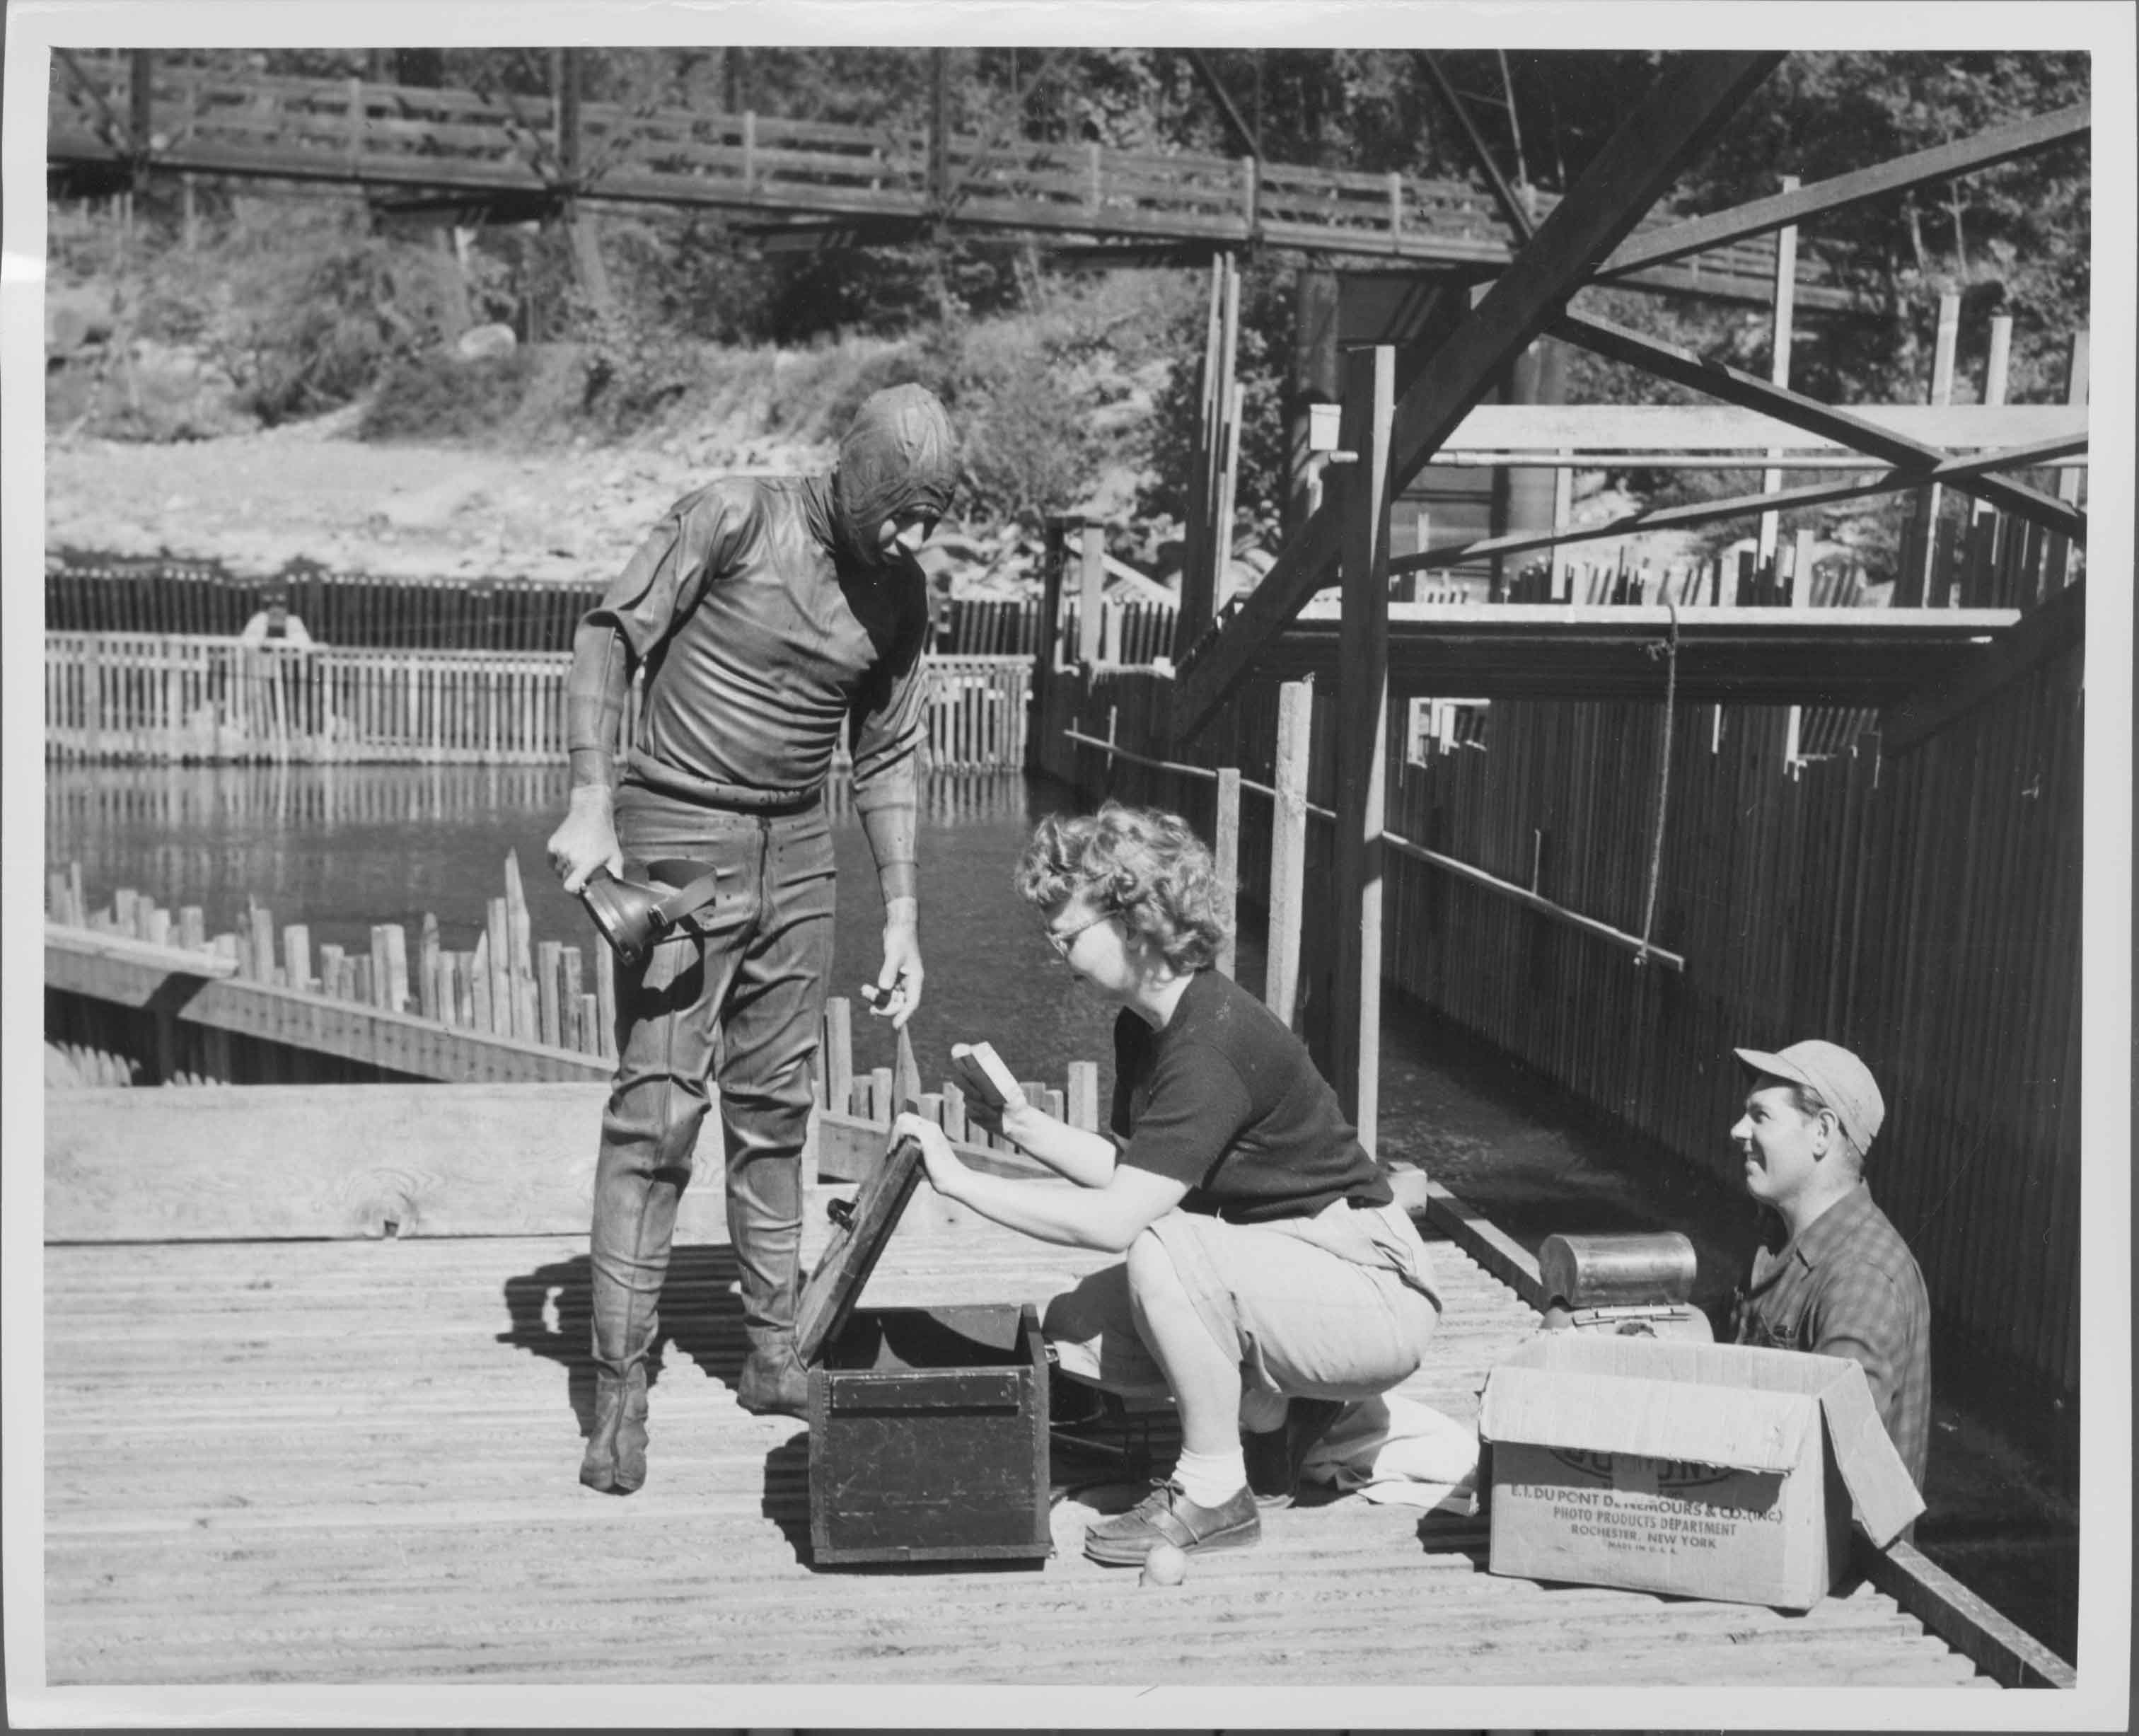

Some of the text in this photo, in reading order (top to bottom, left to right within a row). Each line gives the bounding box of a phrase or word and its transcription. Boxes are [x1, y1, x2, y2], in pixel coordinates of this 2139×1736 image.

[1558, 1490, 1600, 1505] PONT
[1705, 1504, 1716, 1517] &
[1553, 1505, 1737, 1536] PHOTO PRODUCTS DEPARTMENT
[1647, 1532, 1677, 1544] NEW
[1681, 1535, 1717, 1549] YORK
